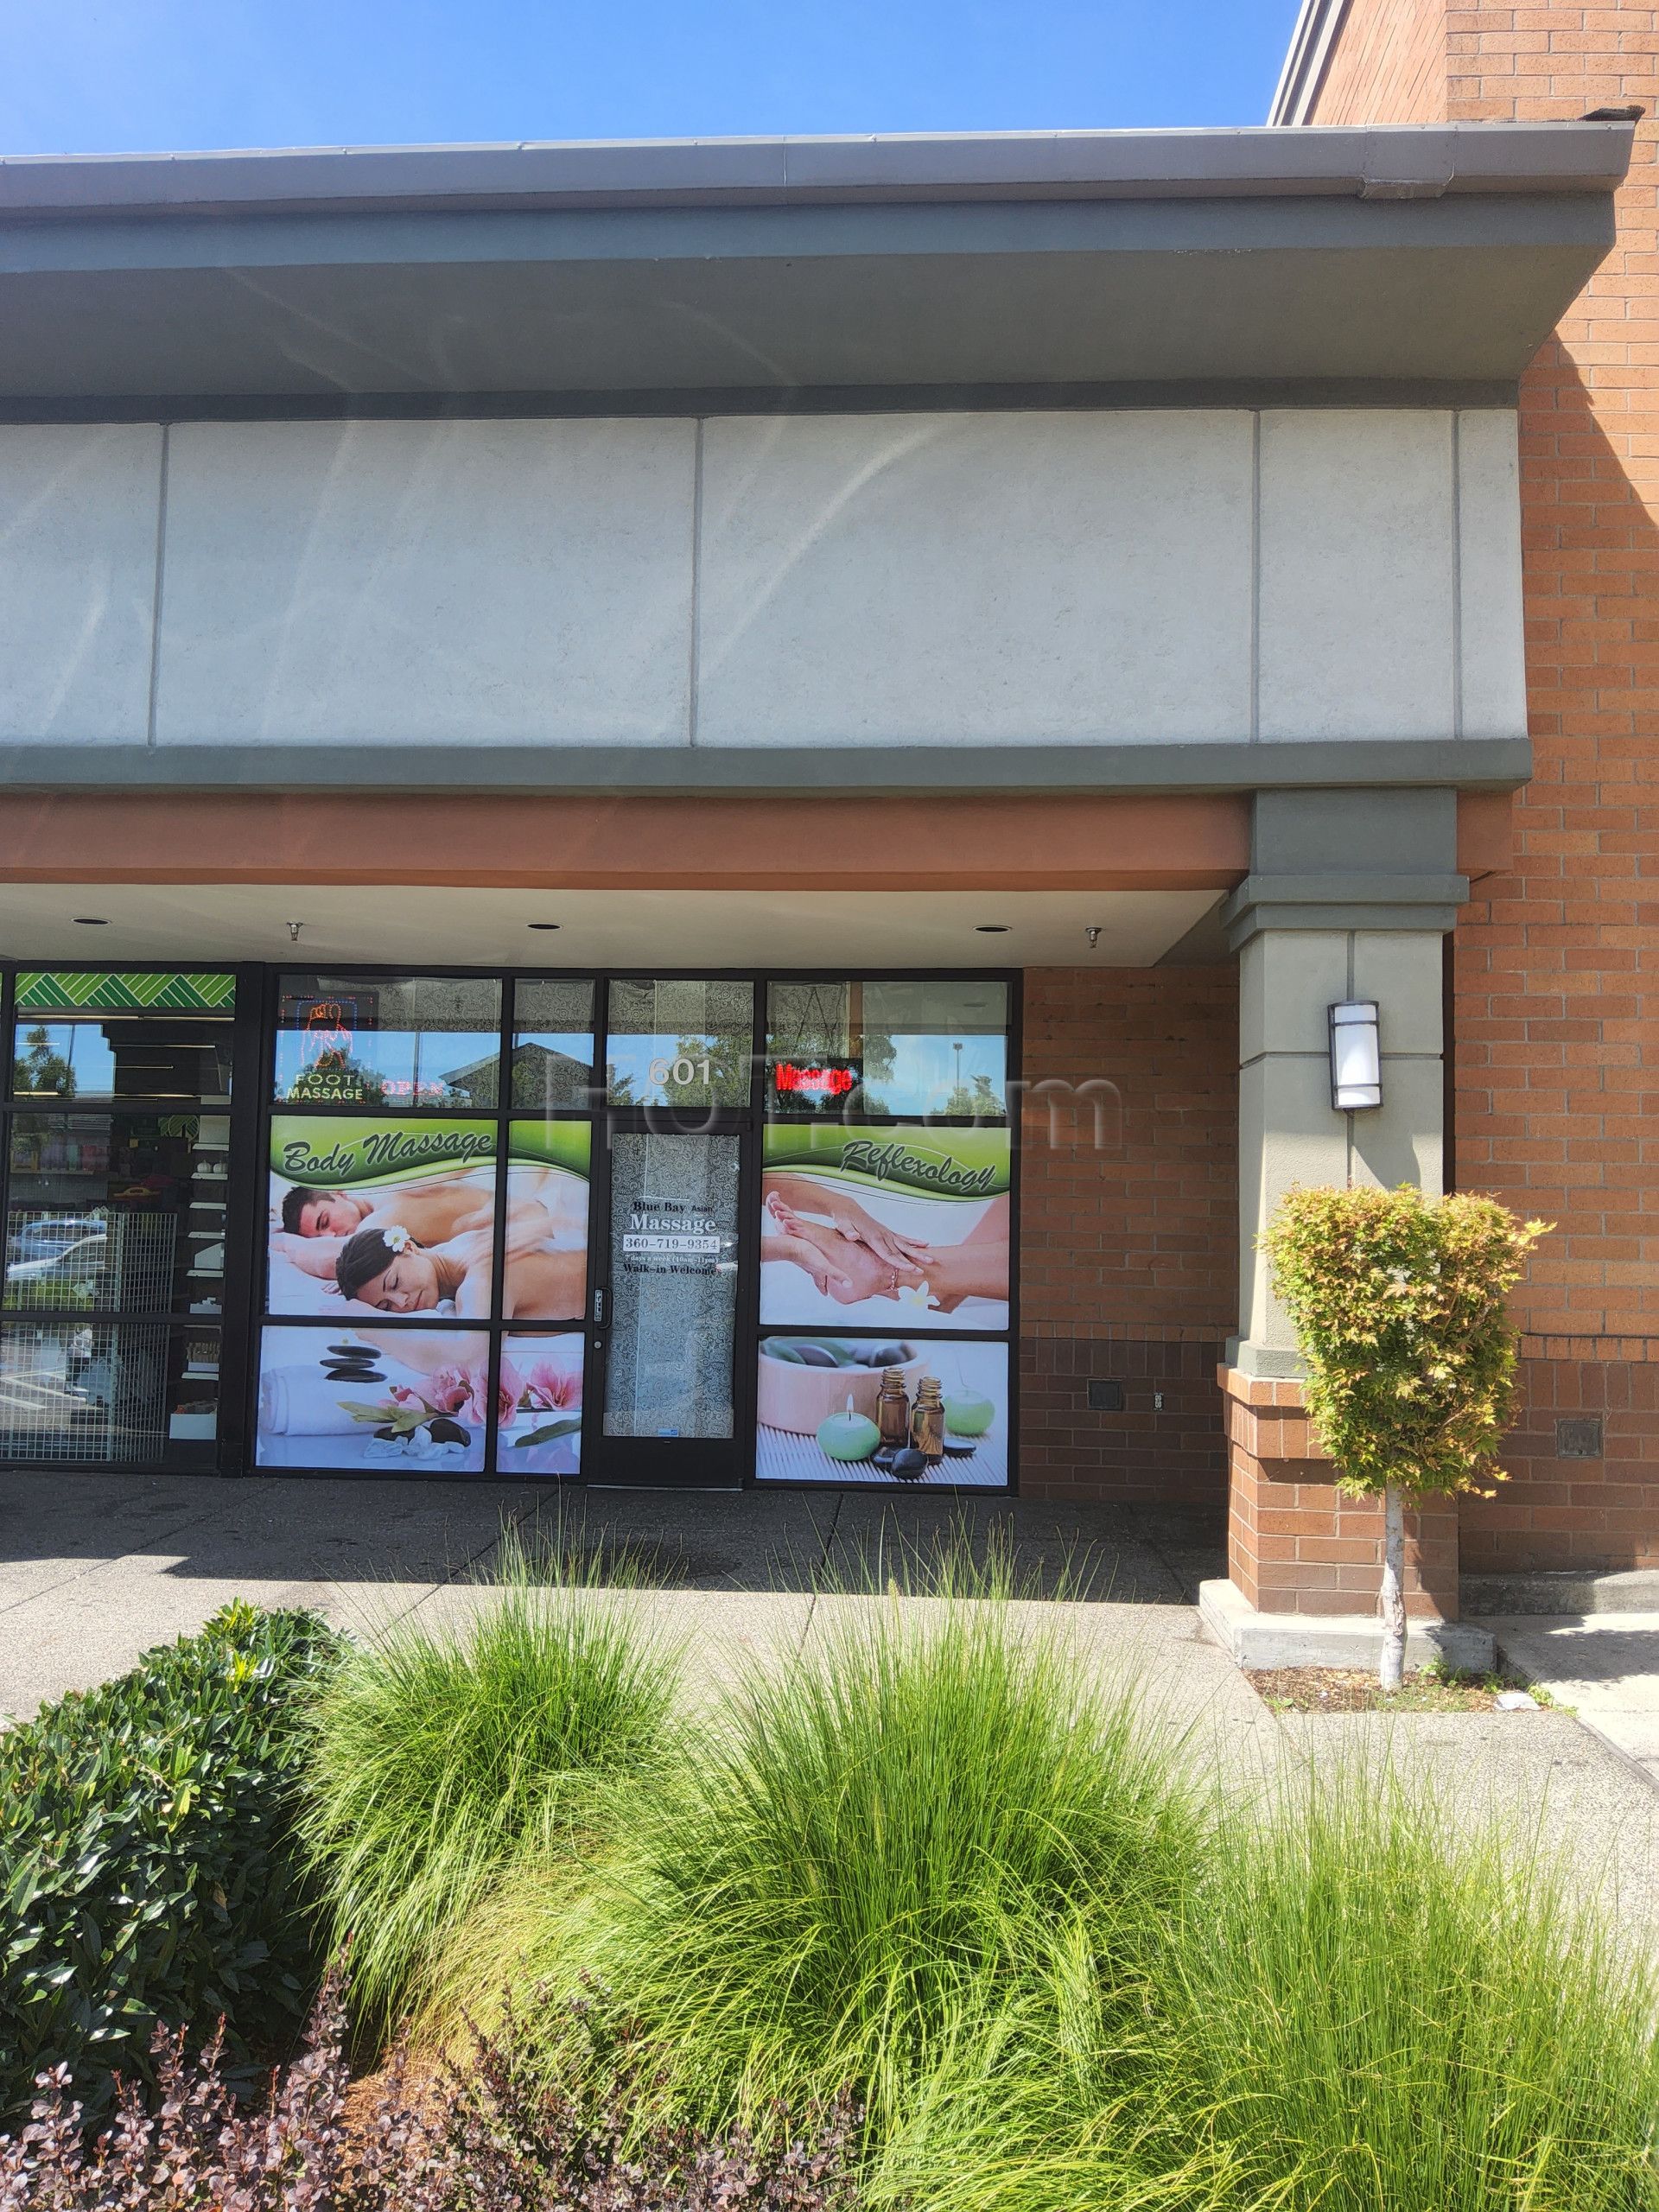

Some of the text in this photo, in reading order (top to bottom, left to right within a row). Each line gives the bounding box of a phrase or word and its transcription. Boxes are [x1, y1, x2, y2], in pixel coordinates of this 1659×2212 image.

[295, 1073, 355, 1085] FOOT
[649, 1058, 710, 1085] 601
[774, 1063, 853, 1096] Massage
[286, 1087, 364, 1101] MASSAGE
[381, 1080, 444, 1097] OPEN
[283, 1130, 493, 1179] Body Massage
[841, 1140, 996, 1192] Reflexology
[633, 1202, 660, 1212] Blue
[664, 1202, 686, 1214] Bay
[629, 1213, 716, 1235] Massage
[626, 1237, 718, 1250] 360-719-9354
[624, 1264, 716, 1275] Walk-in Welcome
